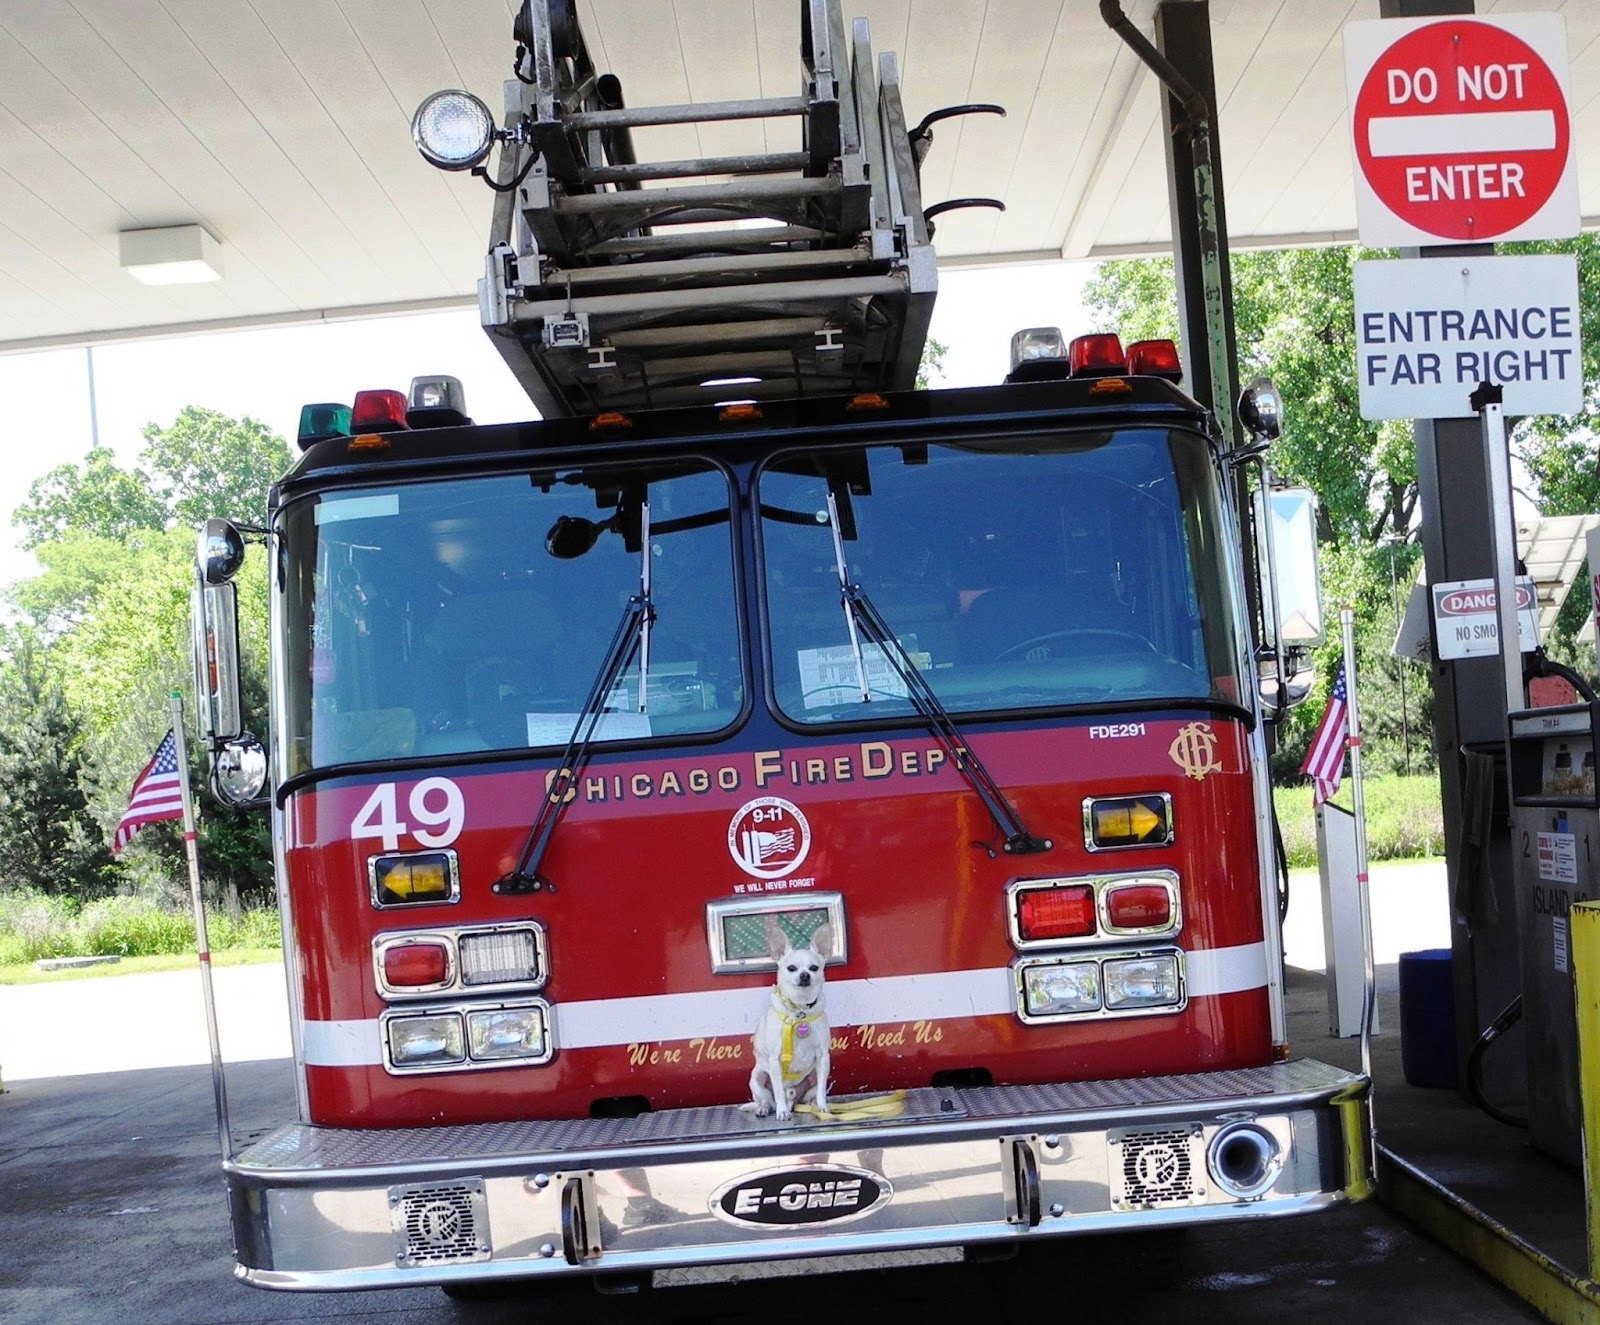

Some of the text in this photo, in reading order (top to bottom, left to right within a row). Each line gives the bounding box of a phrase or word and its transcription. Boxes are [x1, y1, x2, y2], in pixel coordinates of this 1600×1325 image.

[1386, 63, 1529, 105] DO NOT
[1405, 162, 1526, 202] ENTER
[1362, 306, 1573, 344] ENTRANCE
[1366, 348, 1573, 386] FAR RIGHT
[1451, 591, 1521, 611] DANGR
[1456, 621, 1522, 641] NO SMOG
[1089, 723, 1146, 739] FDE291
[544, 766, 740, 804] CHICAGO
[754, 749, 852, 788] FIRE
[350, 776, 466, 850] 49
[752, 806, 783, 823] 9-11
[779, 801, 794, 811] WHO
[1522, 831, 1531, 858] 2
[1583, 834, 1591, 863] 1
[733, 877, 816, 894] WE WILL NEVER FORGET
[1532, 886, 1570, 917] ISLAND
[626, 1018, 944, 1067] We're There ou Need Us
[733, 1178, 863, 1216] E-ONE
